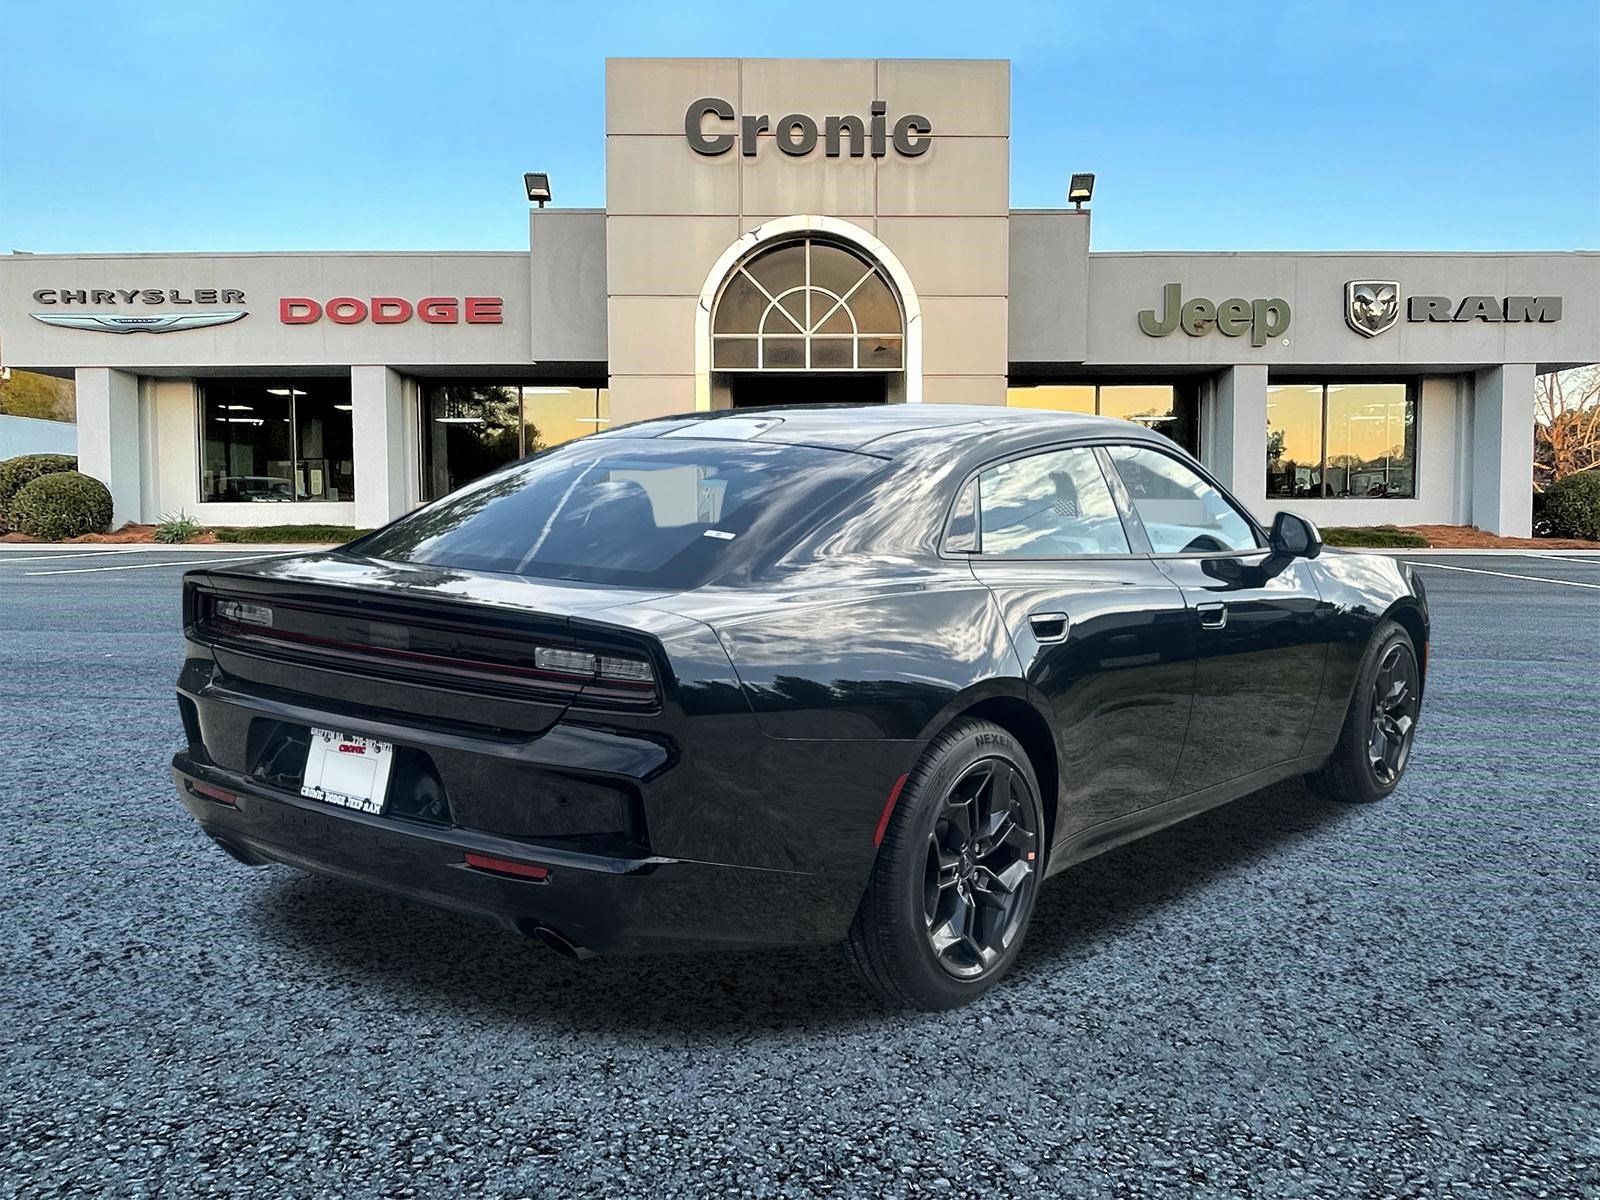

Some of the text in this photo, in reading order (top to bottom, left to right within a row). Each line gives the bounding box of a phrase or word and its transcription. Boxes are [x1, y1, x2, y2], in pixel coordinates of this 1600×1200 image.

[685, 97, 932, 157] Cronic
[32, 288, 247, 305] CHRYSLER
[279, 296, 503, 325] DODGE
[1407, 296, 1563, 323] RAM
[1138, 283, 1291, 347] Jeep
[339, 744, 366, 754] CRONIC
[301, 786, 382, 815] CRONIC DODGE JEEP RAM
